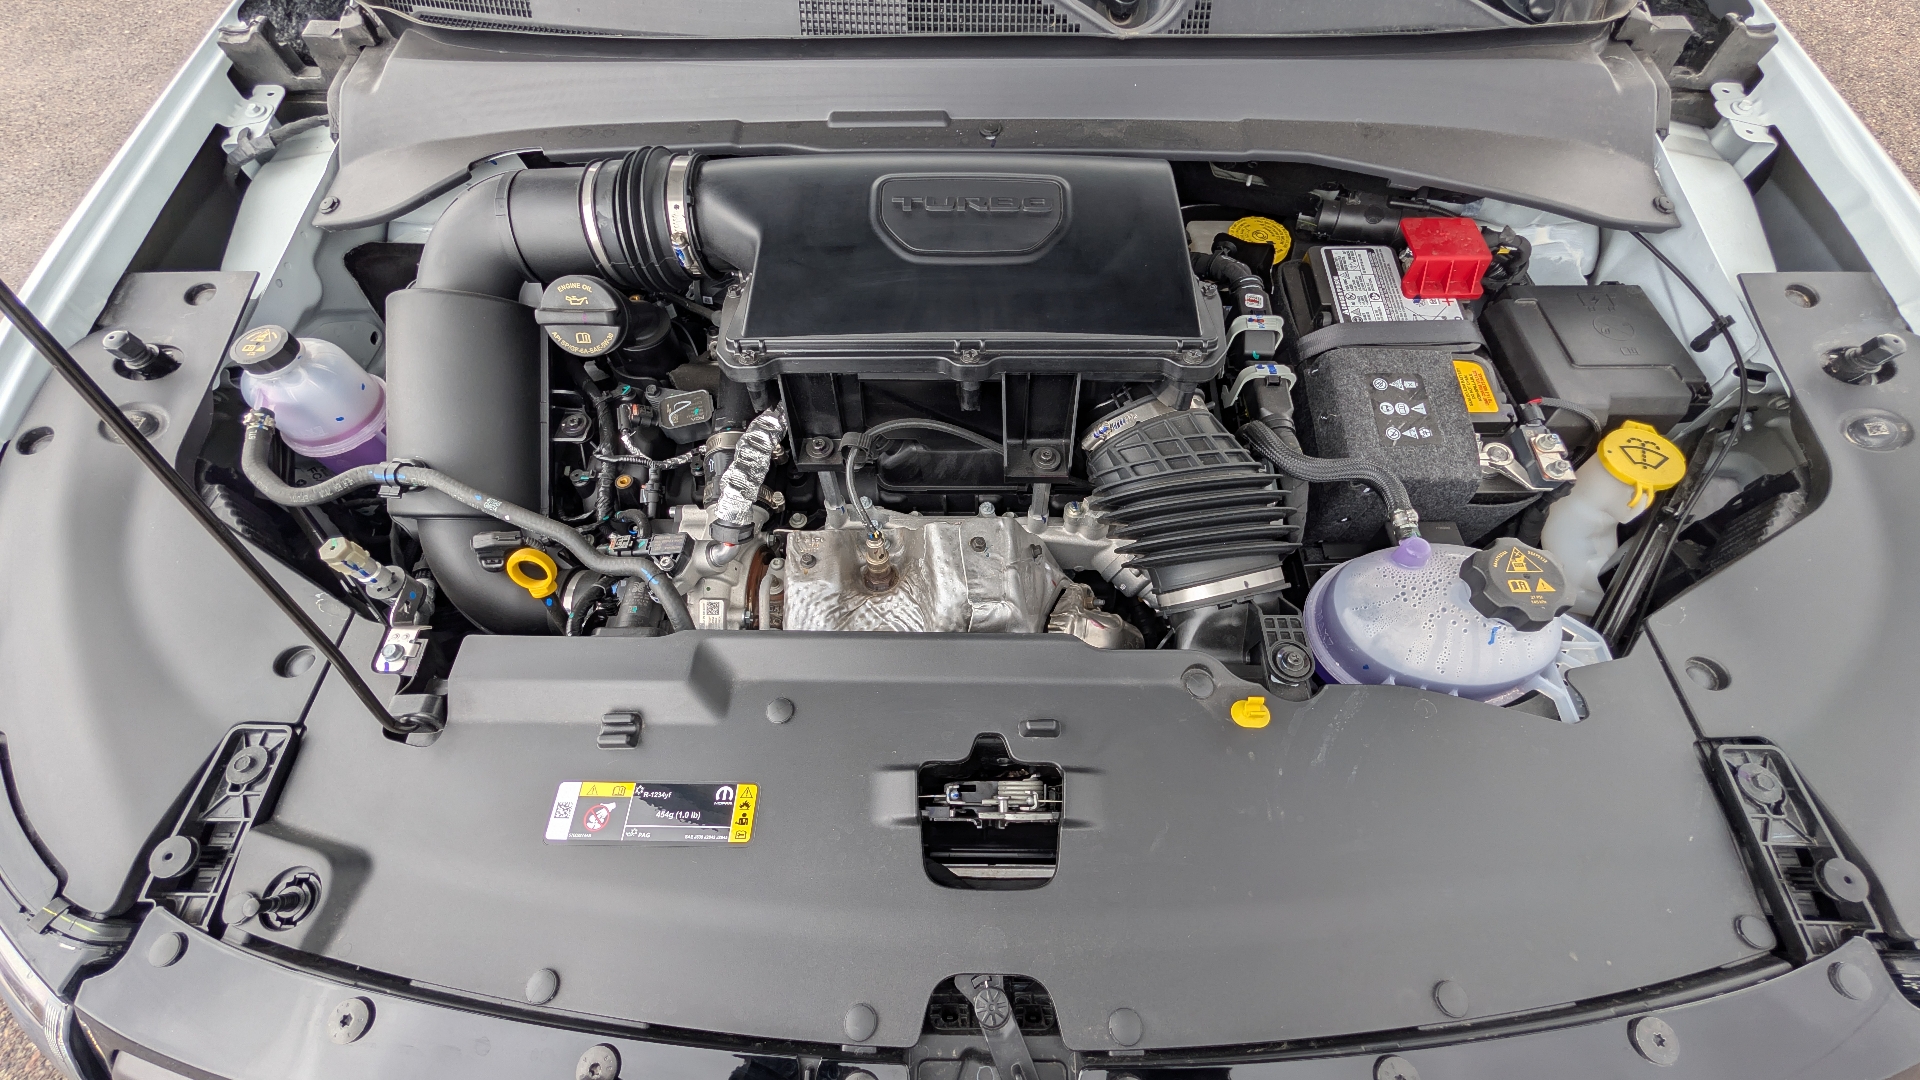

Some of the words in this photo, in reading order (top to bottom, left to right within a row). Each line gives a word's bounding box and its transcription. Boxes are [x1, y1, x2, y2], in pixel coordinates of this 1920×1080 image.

[892, 196, 1052, 212] TURBO
[557, 282, 580, 292] ENGINE
[582, 284, 592, 293] OIL
[552, 332, 562, 342] API
[643, 792, 672, 800] R-1234yf
[656, 811, 674, 819] 454g
[676, 811, 689, 819] (1.0
[690, 811, 701, 820] lb)
